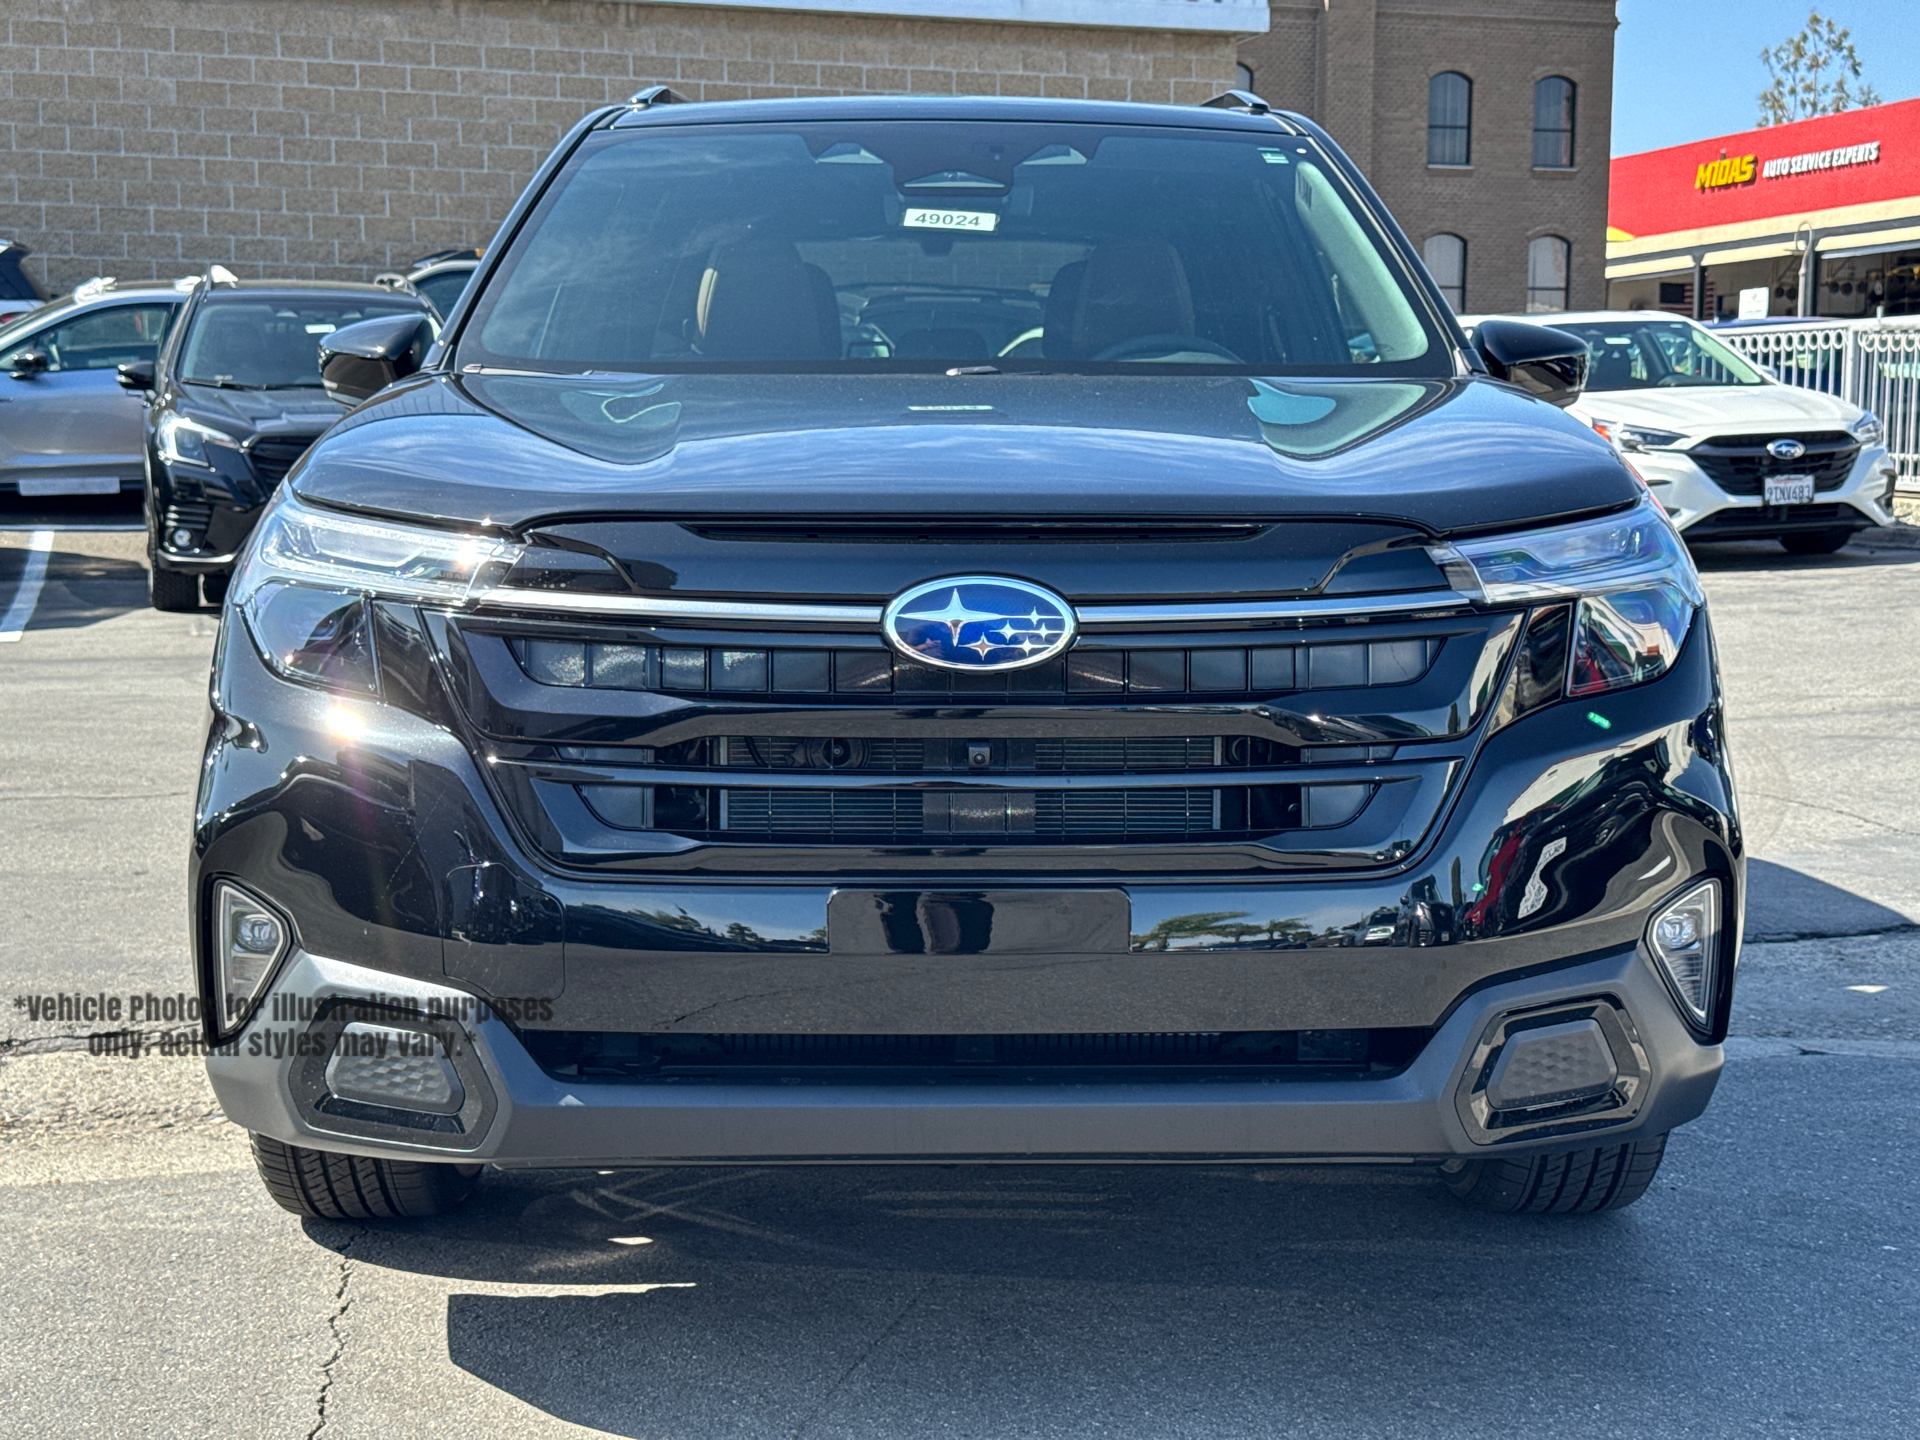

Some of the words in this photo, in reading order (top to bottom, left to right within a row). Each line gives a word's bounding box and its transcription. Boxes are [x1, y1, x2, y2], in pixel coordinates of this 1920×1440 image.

[1694, 154, 1755, 190] MIDAS
[1762, 158, 1791, 178] AUTO
[1790, 150, 1832, 174] SERVICE
[1832, 141, 1880, 167] EXPERTS
[914, 213, 981, 227] 49024
